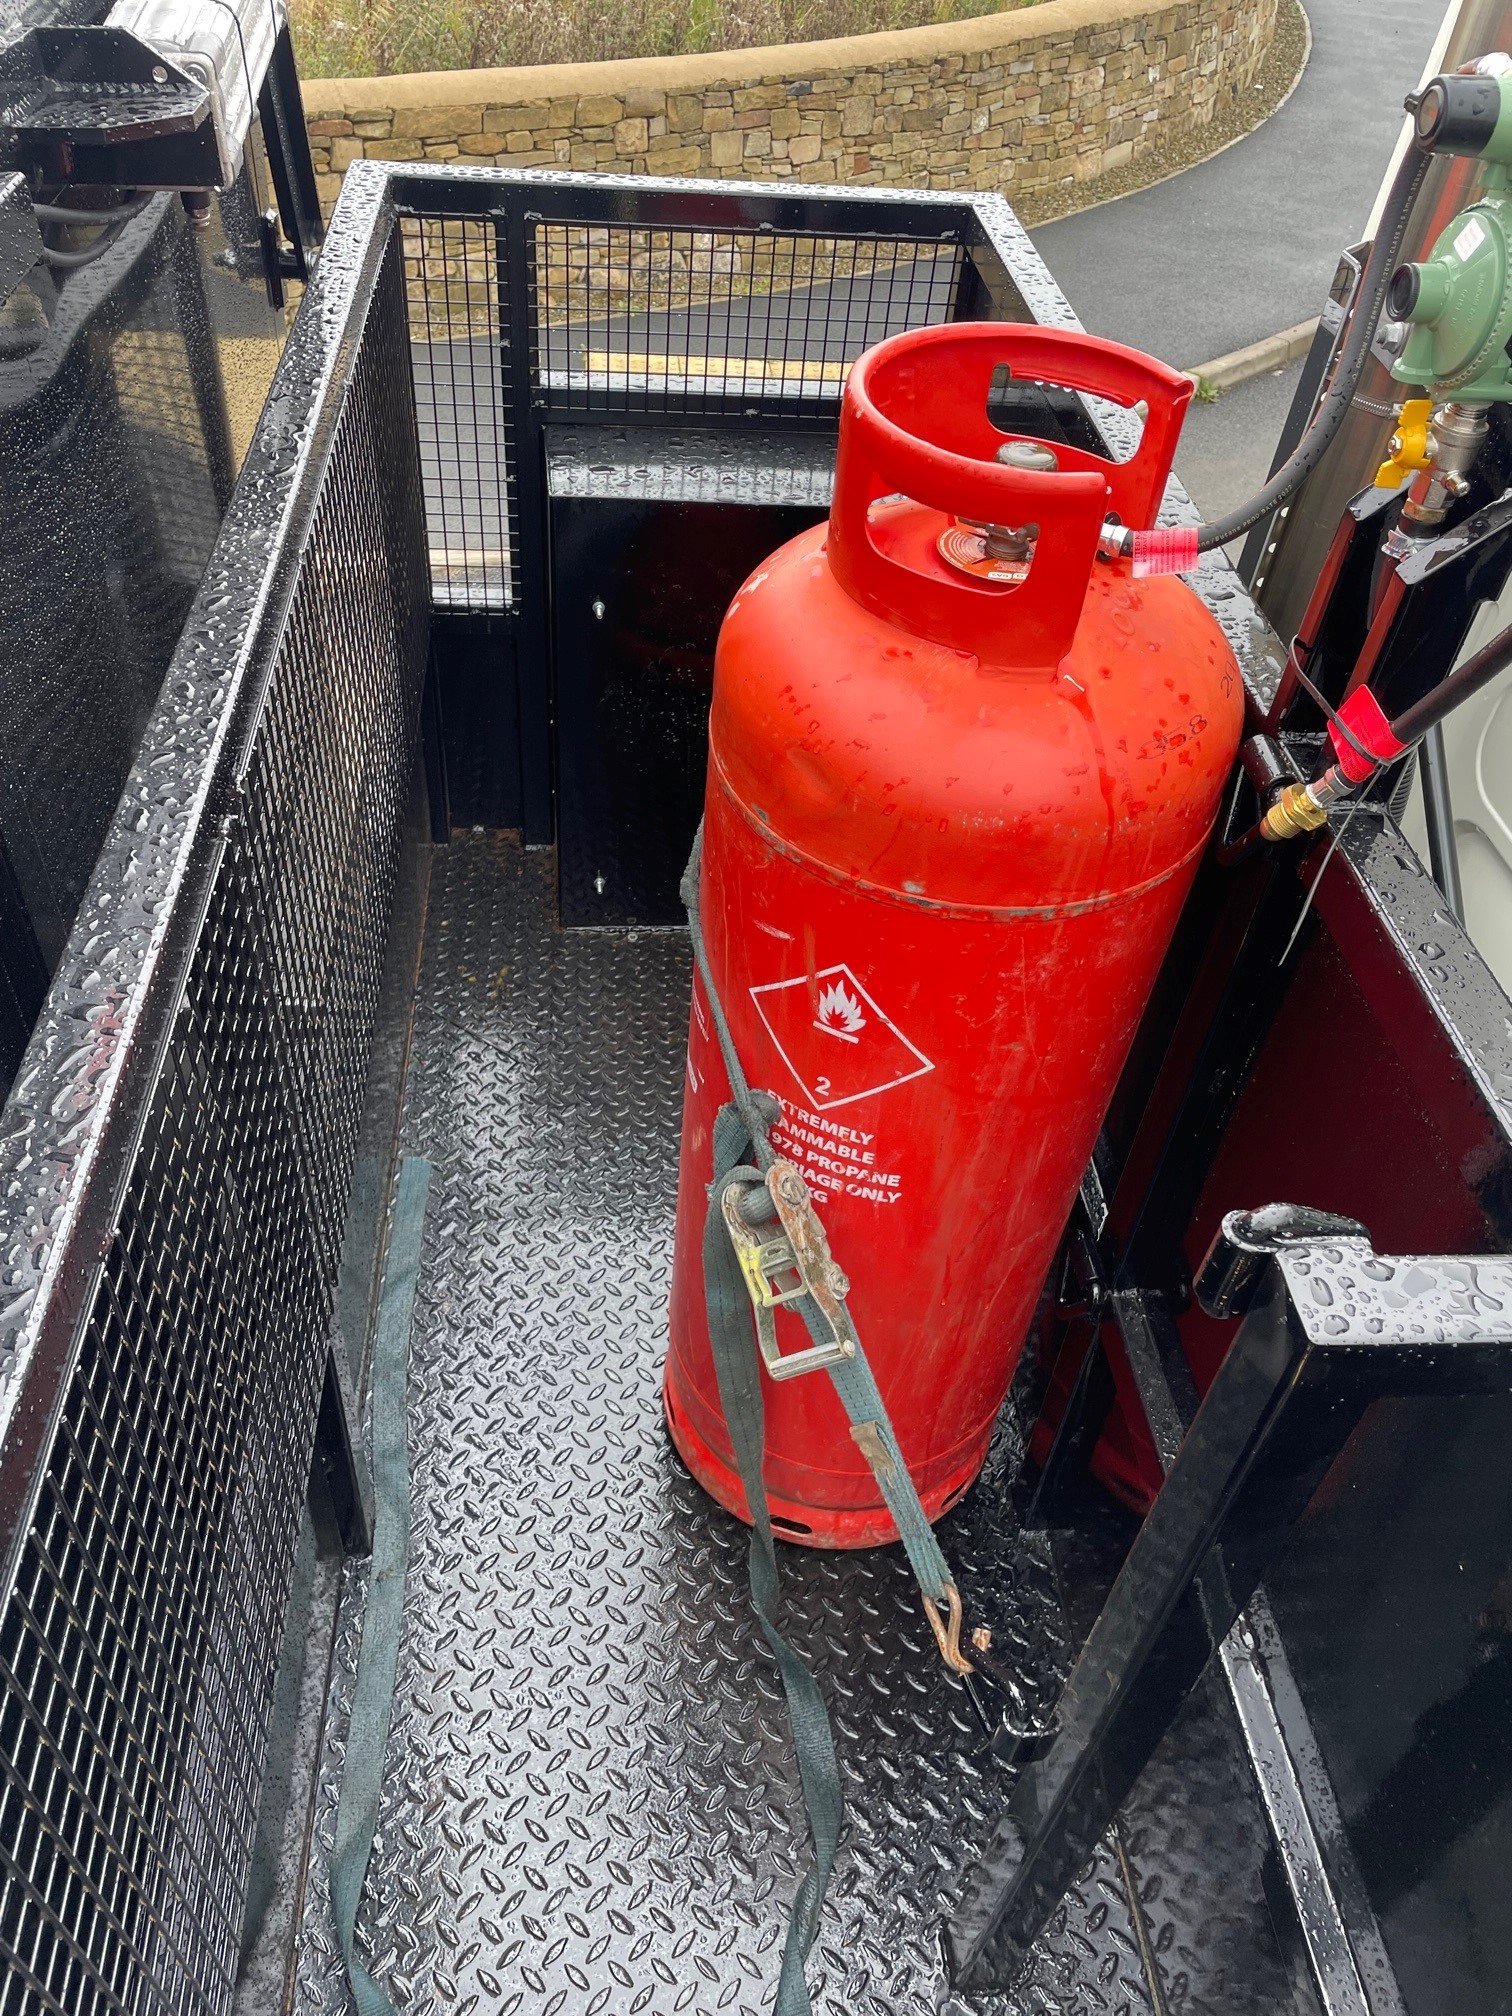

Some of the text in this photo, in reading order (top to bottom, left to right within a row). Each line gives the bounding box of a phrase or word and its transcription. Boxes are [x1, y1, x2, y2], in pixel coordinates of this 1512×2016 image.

[1390, 231, 1401, 254] CLASS
[1243, 513, 1260, 528] PROD
[1261, 500, 1278, 514] DATE
[814, 1076, 831, 1097] 2
[767, 1088, 874, 1146] EXTREMELY
[775, 1117, 875, 1165] AMMABLE
[806, 1150, 901, 1188] PROPANE
[845, 1183, 902, 1204] ONLY
